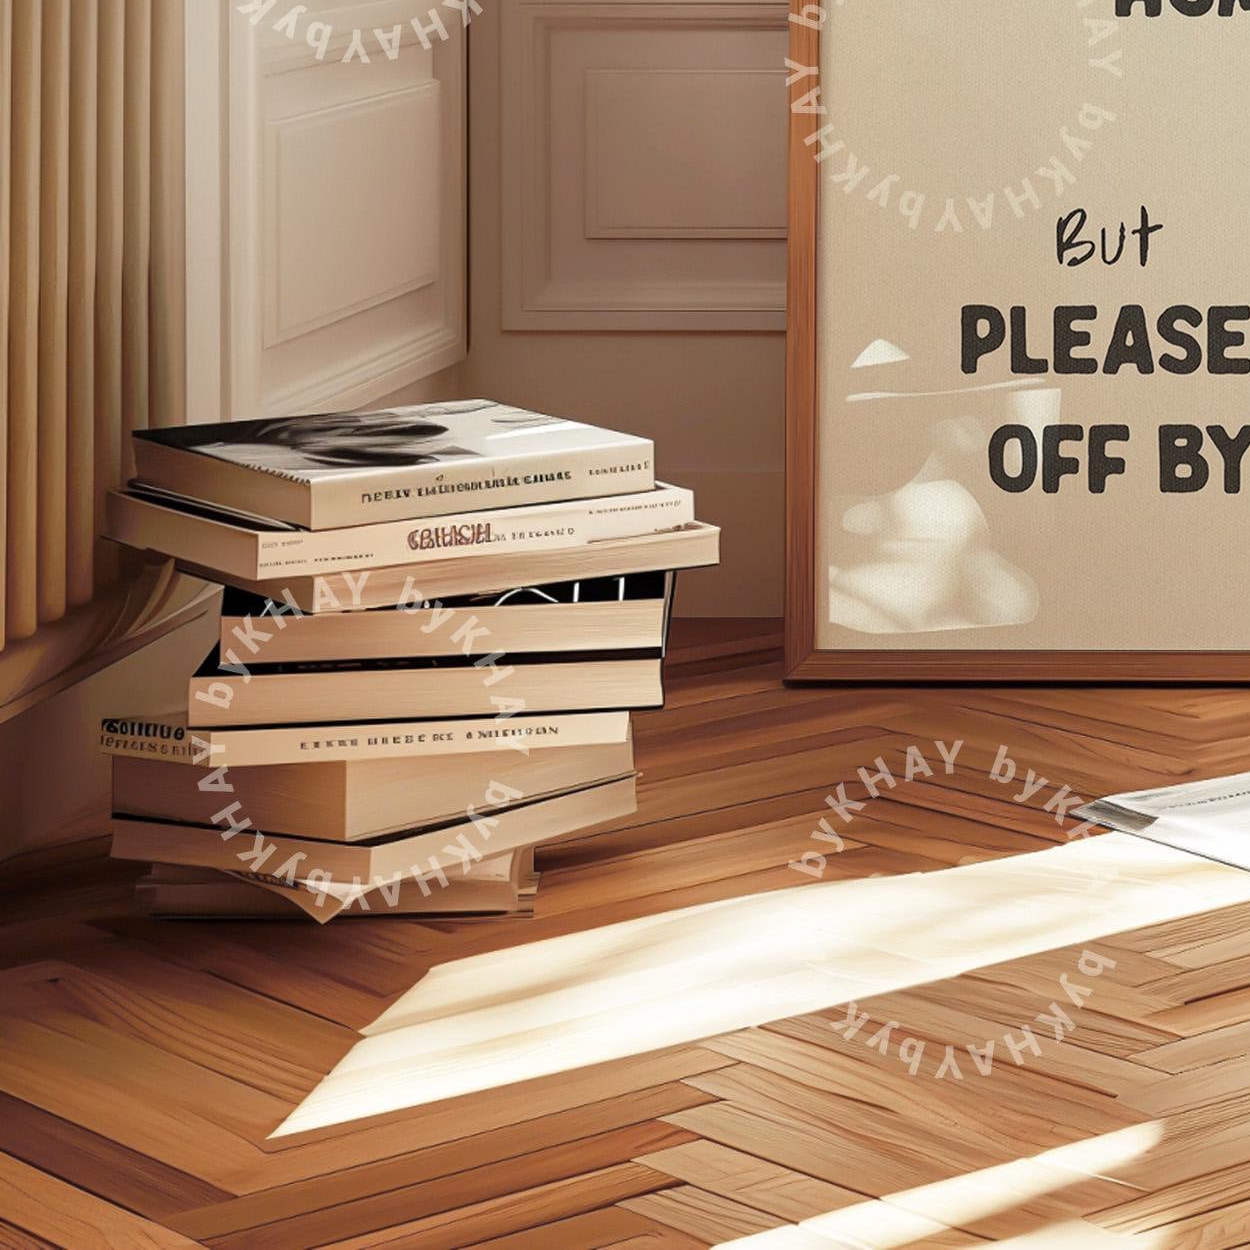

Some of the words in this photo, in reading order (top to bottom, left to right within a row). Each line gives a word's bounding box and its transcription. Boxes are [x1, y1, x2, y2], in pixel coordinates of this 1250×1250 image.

[1057, 206, 1163, 266] But
[961, 305, 1250, 374] PLEASE
[989, 425, 1129, 493] OFF
